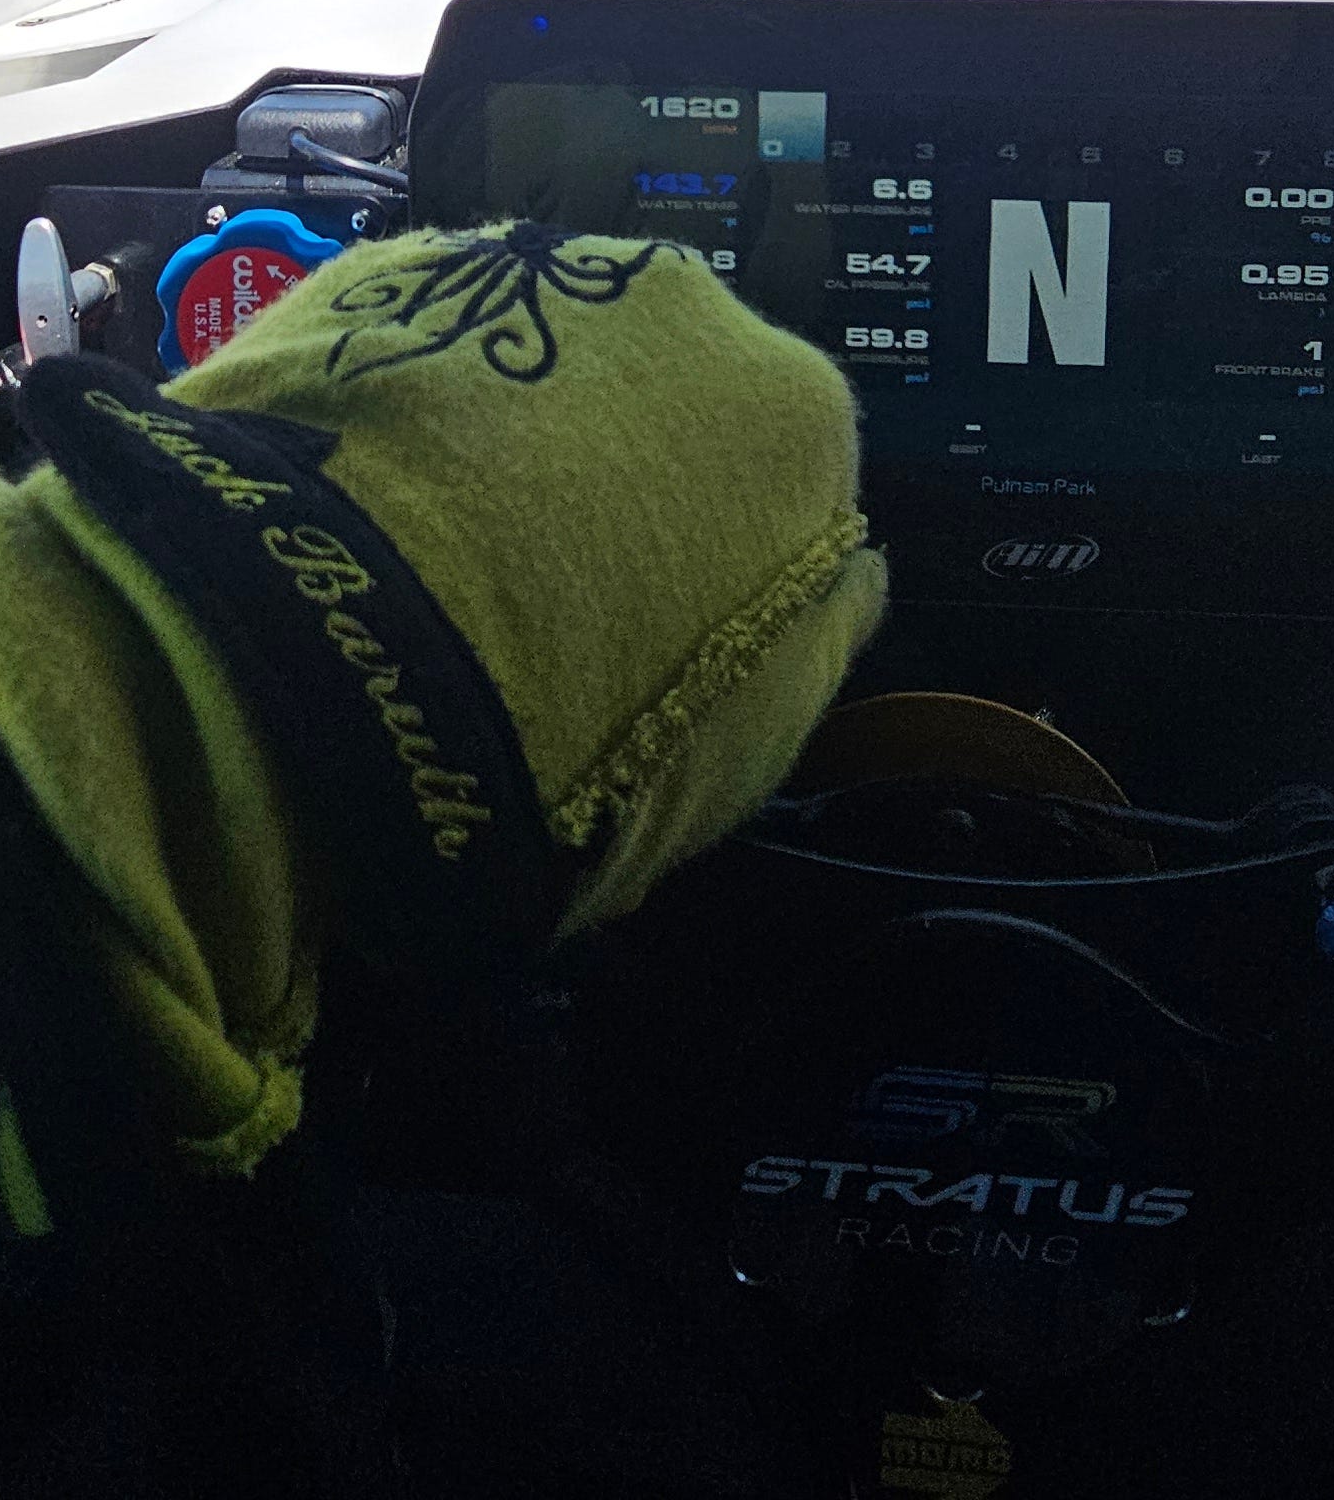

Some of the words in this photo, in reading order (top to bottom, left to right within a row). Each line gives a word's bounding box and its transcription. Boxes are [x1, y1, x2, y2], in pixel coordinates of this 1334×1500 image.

[641, 96, 740, 118] 1620
[873, 179, 933, 200] 6.6
[1245, 187, 1334, 209] 0.00
[846, 253, 931, 275] 54.7
[1241, 264, 1329, 286] 0.95
[987, 199, 1110, 366] N
[1258, 290, 1328, 302] LAMBDA
[194, 303, 207, 343] U.S.A.
[209, 297, 222, 335] MADE
[846, 327, 929, 349] 59.8
[1303, 341, 1323, 361] 1
[981, 475, 1049, 495] Putnam
[1054, 477, 1097, 496] Park
[261, 524, 492, 861] Baruth
[741, 1156, 1194, 1227] STRATUS
[835, 1217, 1081, 1266] RACING
